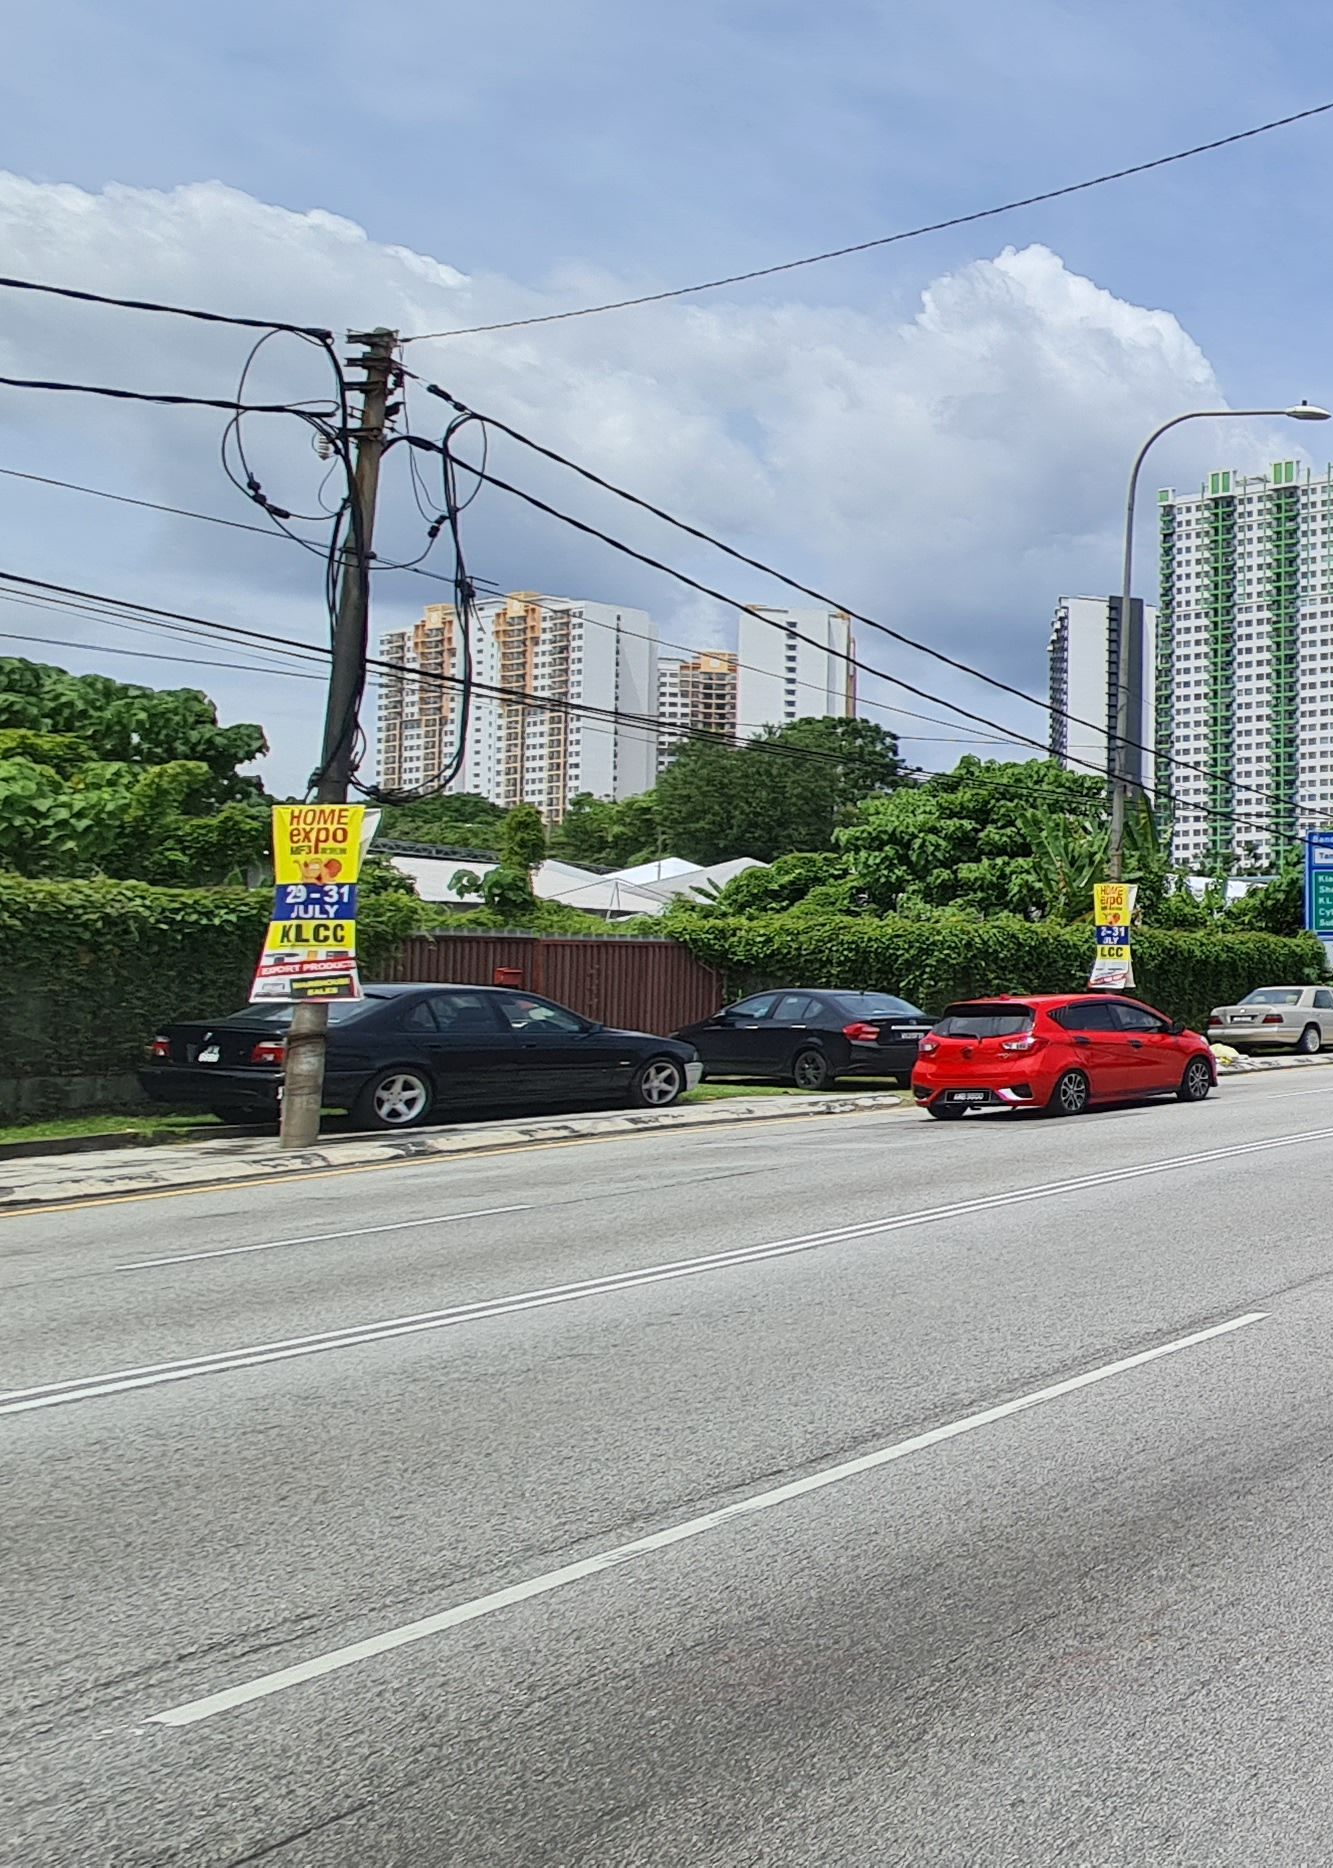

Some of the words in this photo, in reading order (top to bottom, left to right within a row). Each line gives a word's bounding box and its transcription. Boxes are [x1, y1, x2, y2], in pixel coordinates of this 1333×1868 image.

[289, 807, 350, 826] HOME
[289, 826, 349, 855] expo
[285, 885, 308, 904] 29
[323, 885, 350, 903] 31
[1100, 885, 1124, 896] HOME
[289, 903, 339, 919] JULY
[279, 922, 346, 944] KLCC
